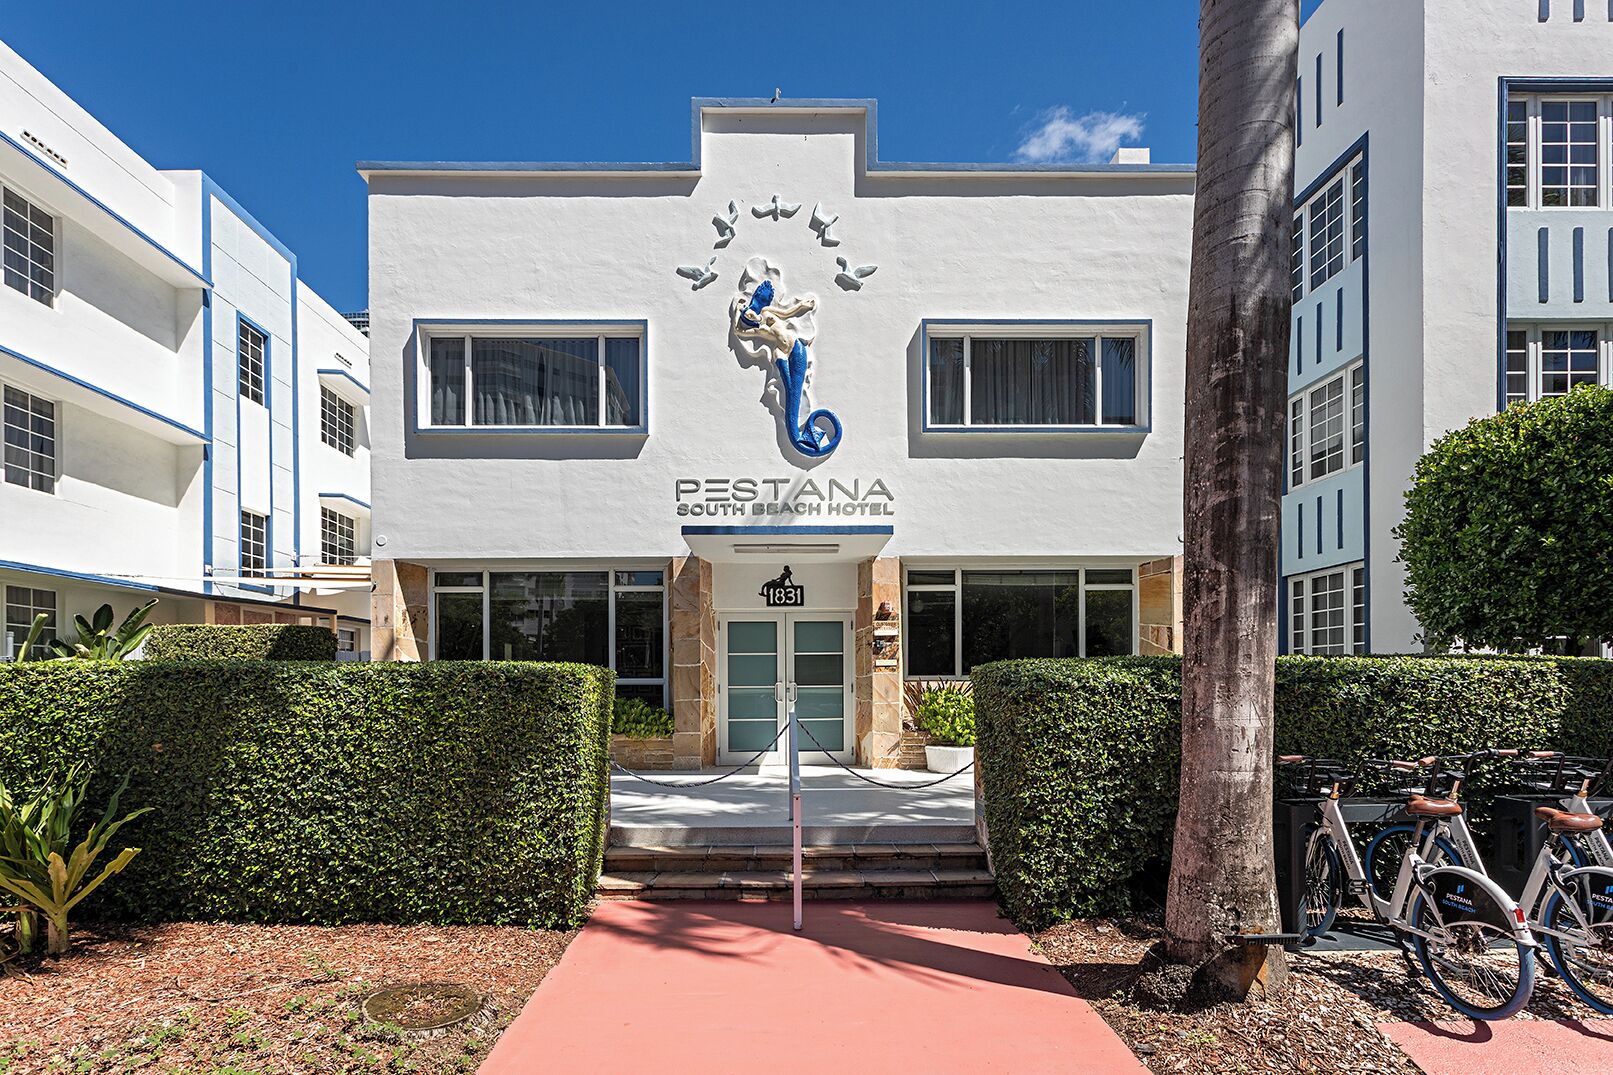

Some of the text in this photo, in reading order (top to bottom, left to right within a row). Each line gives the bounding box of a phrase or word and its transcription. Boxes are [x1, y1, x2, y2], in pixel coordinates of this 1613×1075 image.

[675, 478, 895, 502] PESTANA
[676, 502, 895, 517] SOUTH BEACH HOTEL
[769, 588, 801, 604] 1831
[1442, 899, 1476, 913] SOUTH BEACH
[1446, 893, 1472, 906] PESTANA
